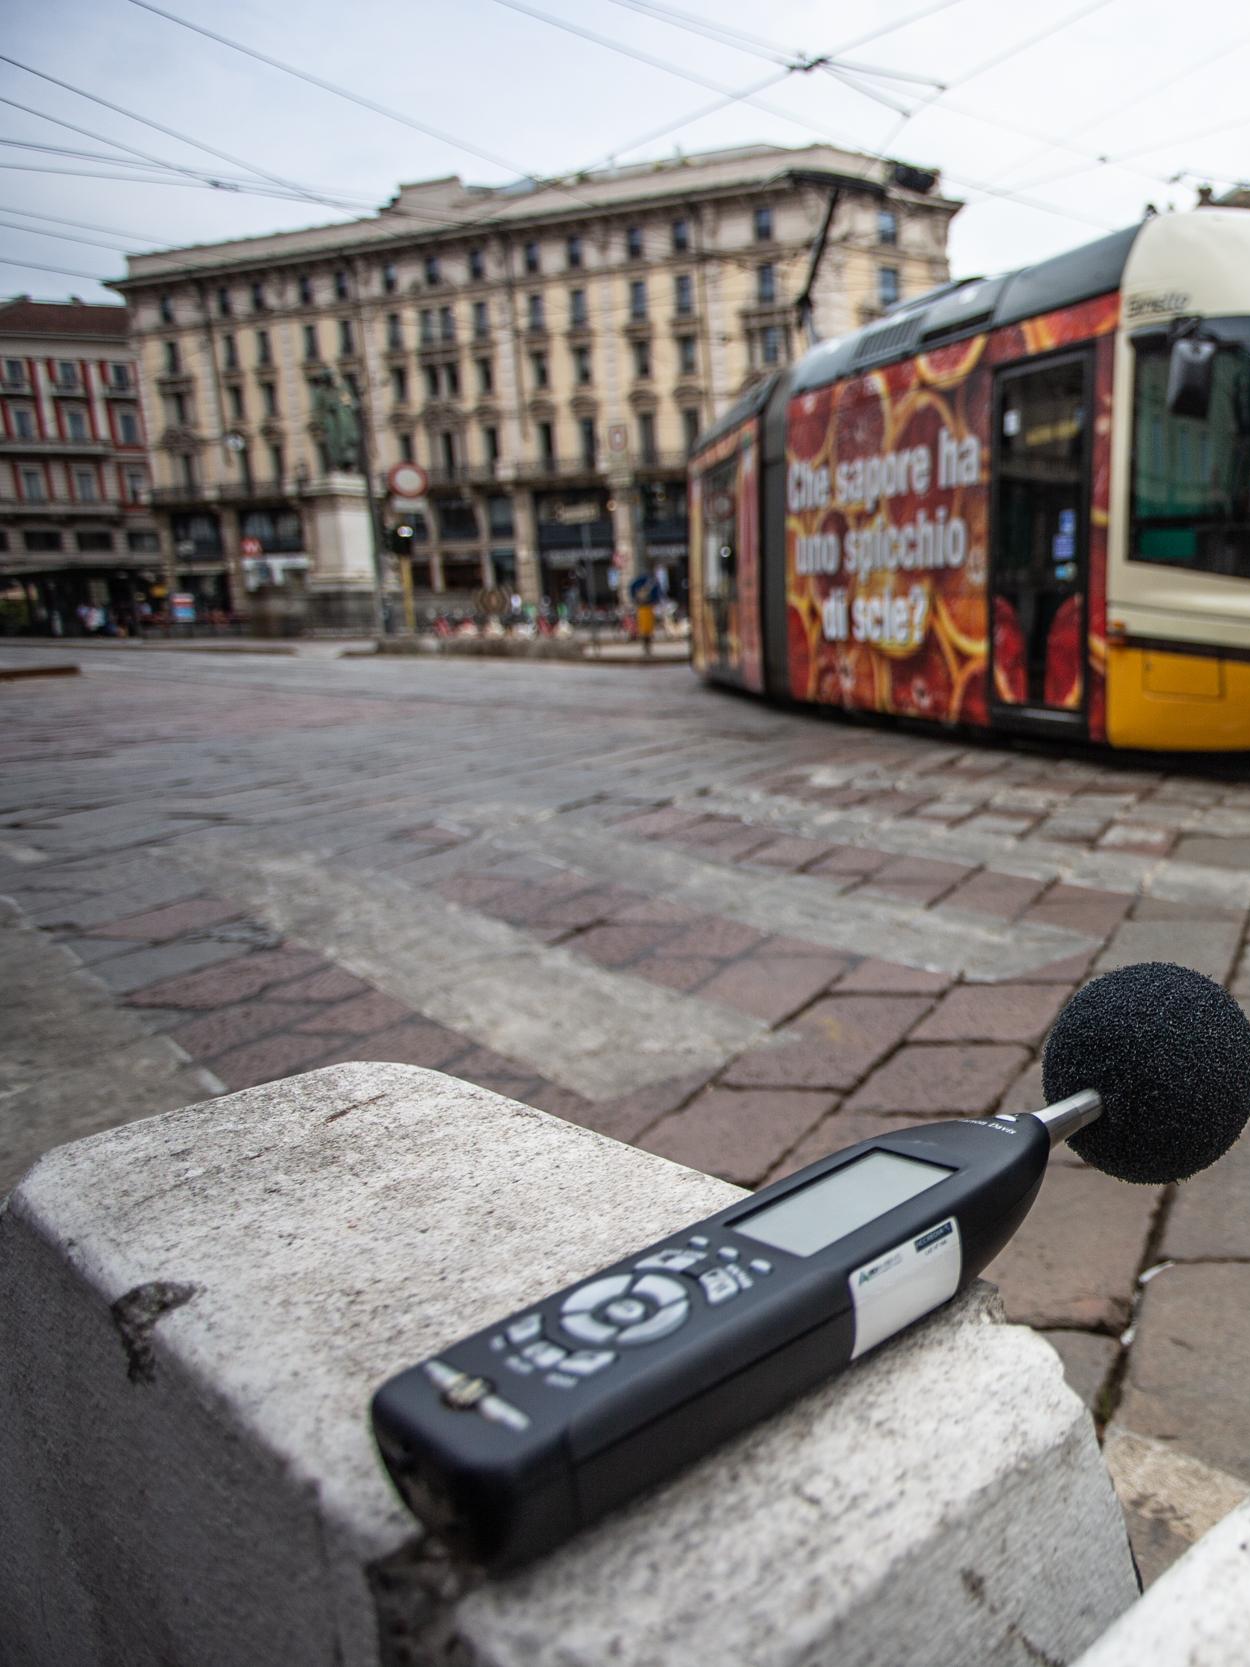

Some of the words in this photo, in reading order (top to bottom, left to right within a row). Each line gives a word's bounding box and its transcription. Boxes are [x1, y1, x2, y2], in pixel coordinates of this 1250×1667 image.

[788, 459, 830, 513] Che
[835, 445, 931, 513] sapore
[937, 426, 982, 490] ha
[795, 532, 840, 577] uno
[844, 505, 966, 584] spicchio
[822, 587, 848, 641] di
